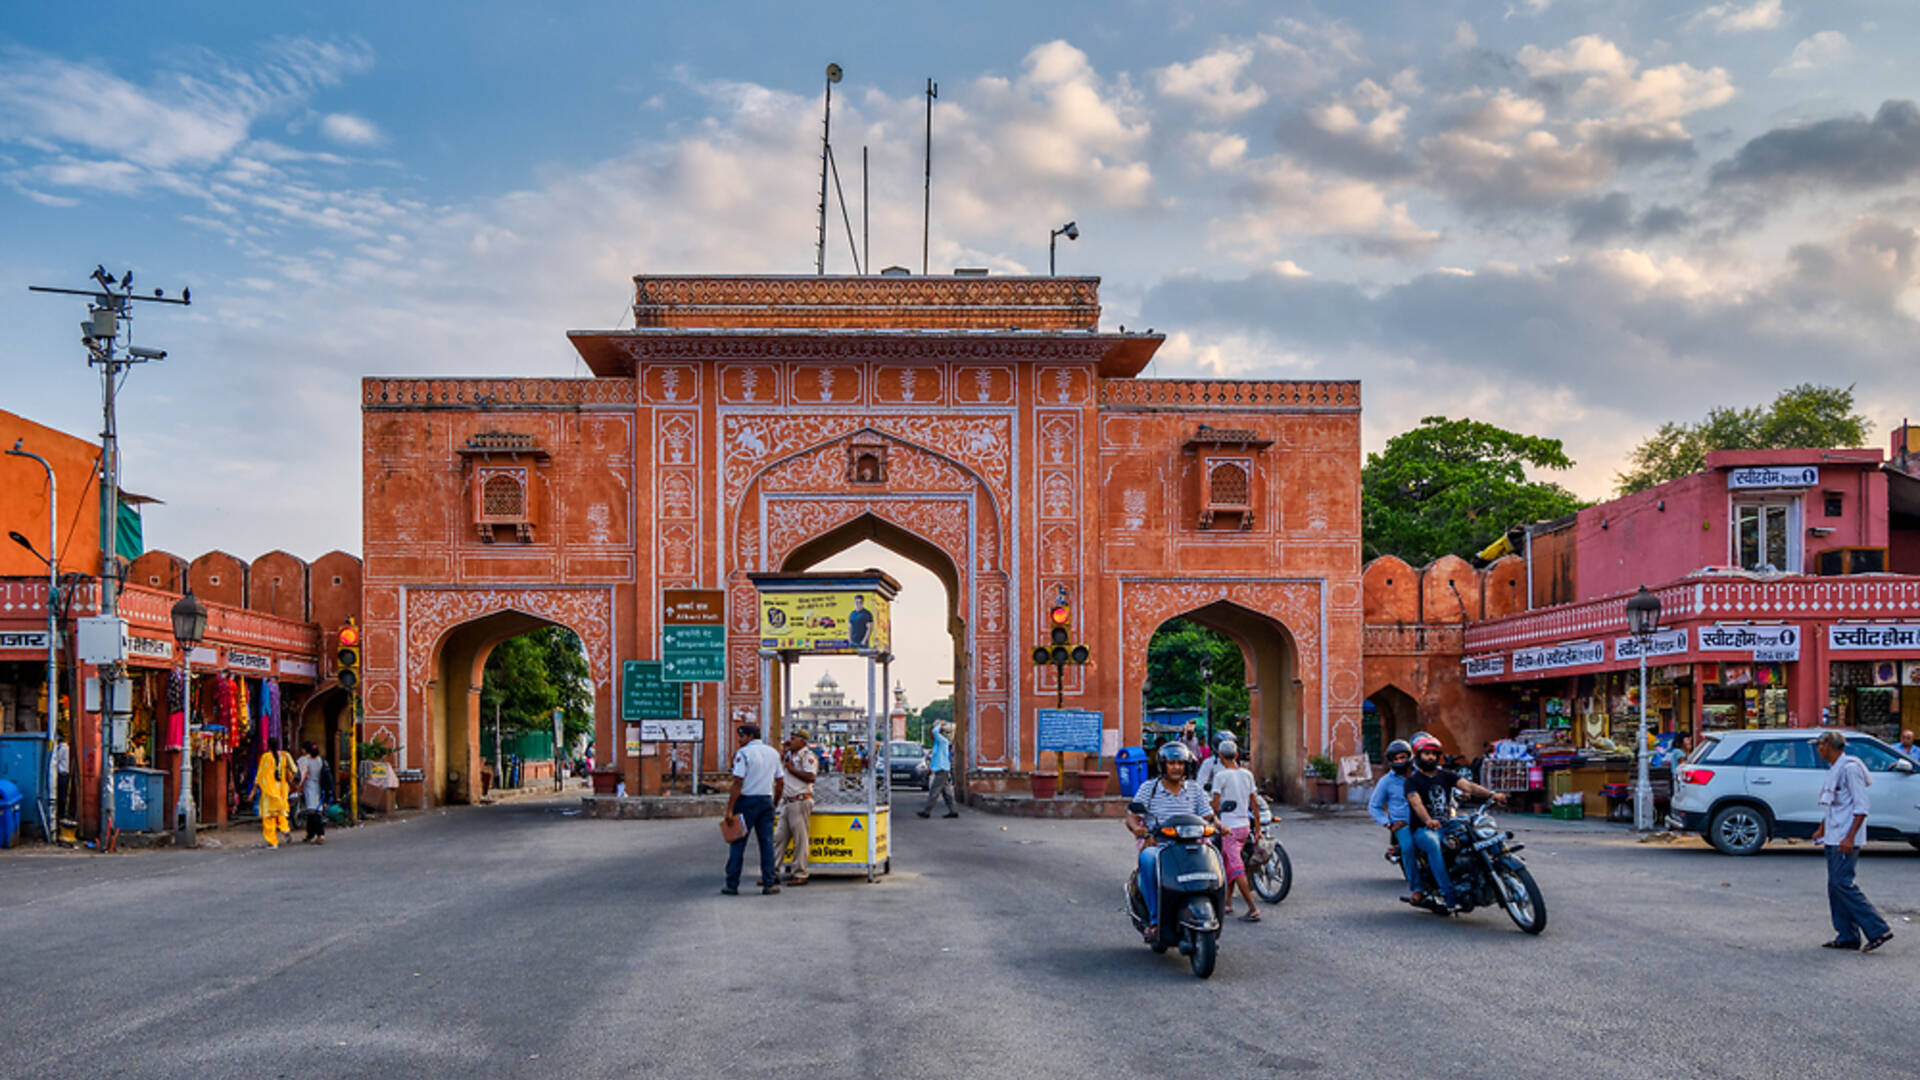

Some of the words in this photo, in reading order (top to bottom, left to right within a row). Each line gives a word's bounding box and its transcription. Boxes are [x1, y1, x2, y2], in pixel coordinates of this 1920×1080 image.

[0, 633, 46, 646] ाजार
[1702, 628, 1734, 646] स्वीट
[1735, 628, 1756, 648] होम
[1832, 627, 1880, 646] स्वीट
[1882, 627, 1914, 647] होम
